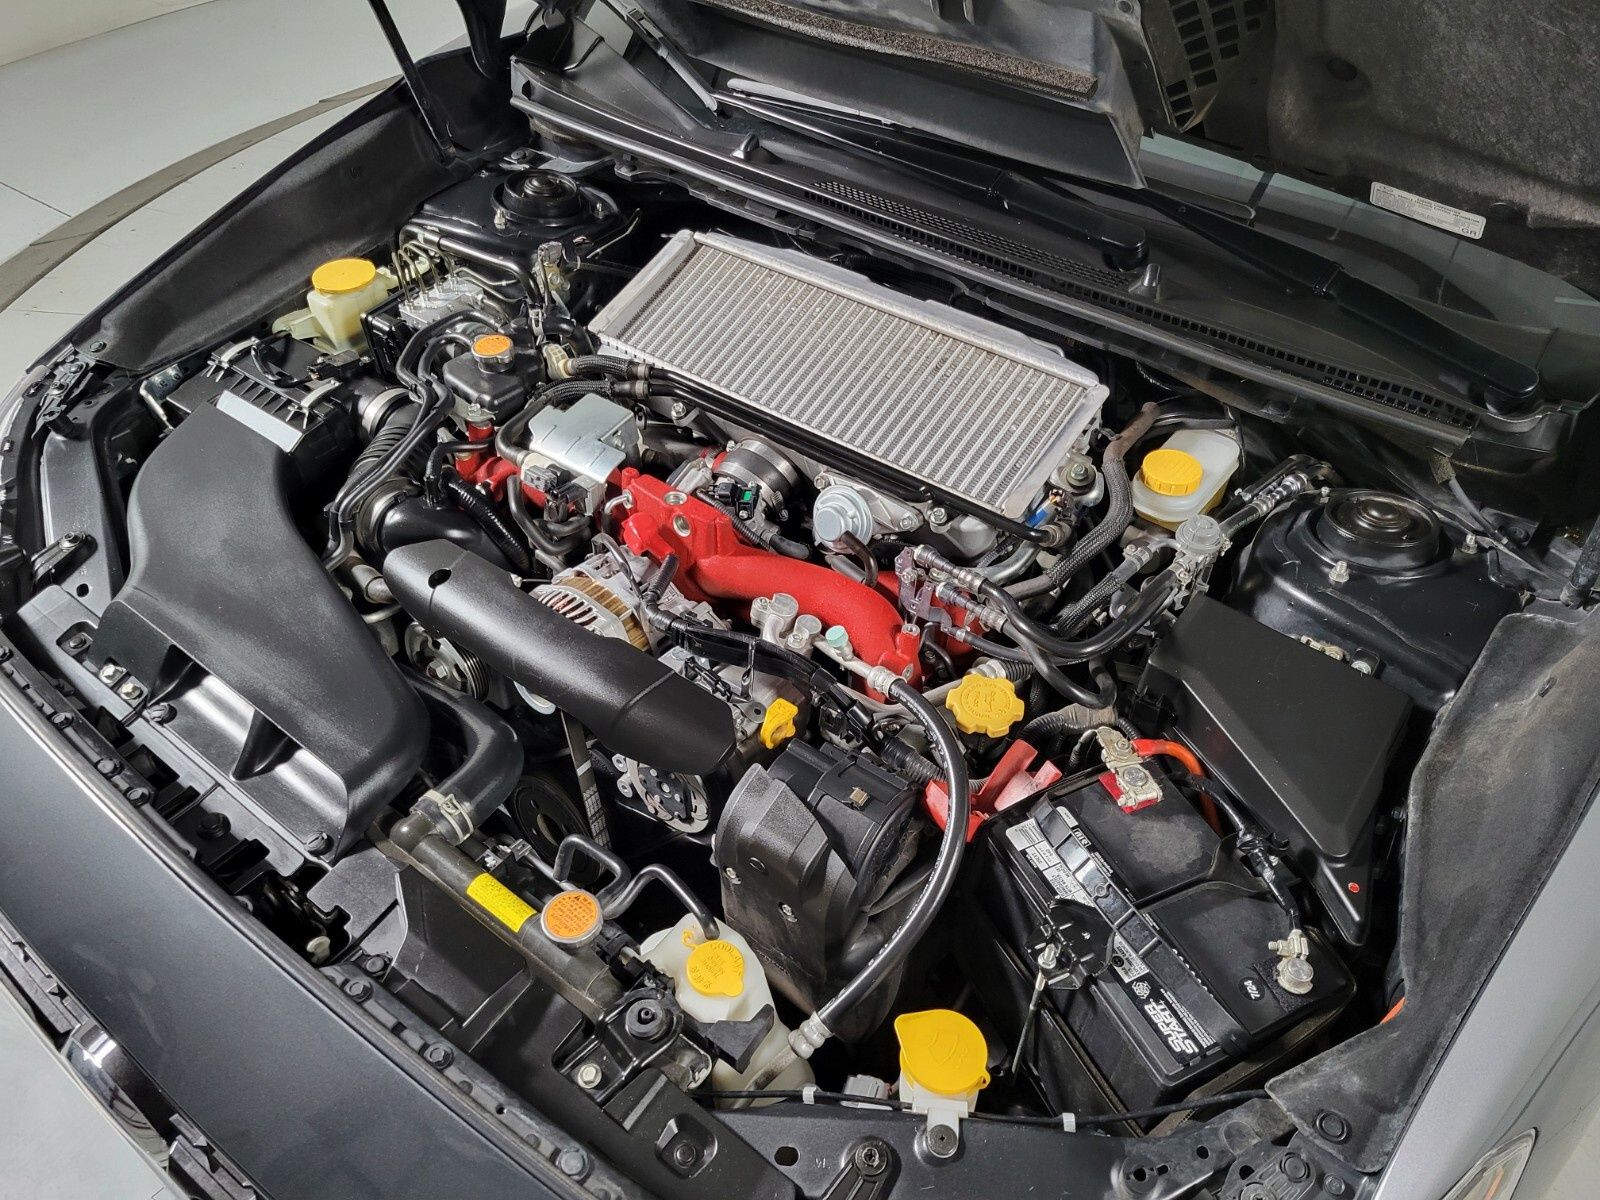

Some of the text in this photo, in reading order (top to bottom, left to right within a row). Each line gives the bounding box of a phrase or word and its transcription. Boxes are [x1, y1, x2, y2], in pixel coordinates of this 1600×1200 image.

[1243, 980, 1260, 1000] 7/24
[1144, 1004, 1182, 1052] SUPER
[1151, 1001, 1199, 1054] START
